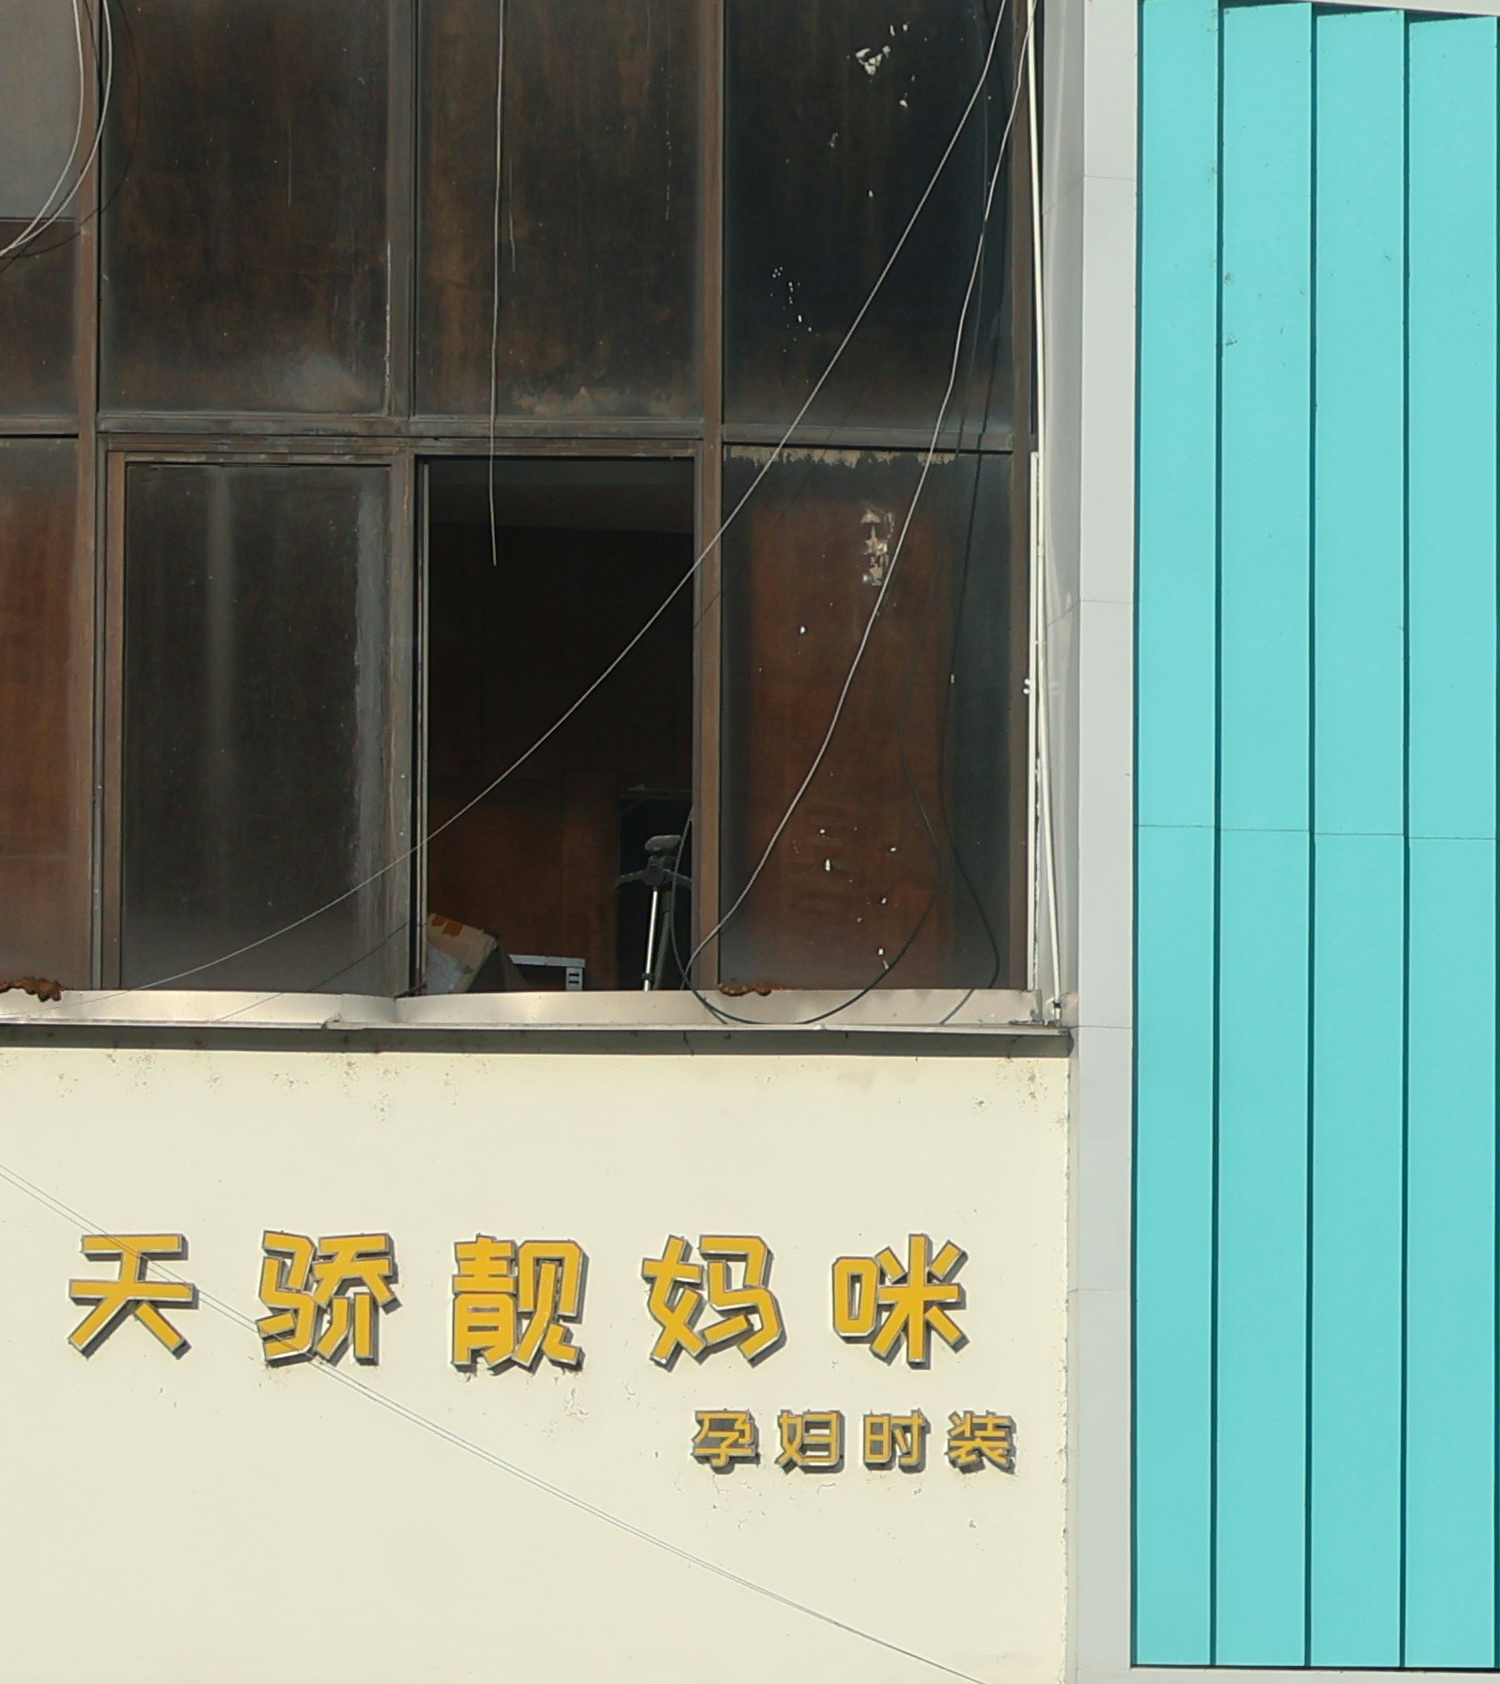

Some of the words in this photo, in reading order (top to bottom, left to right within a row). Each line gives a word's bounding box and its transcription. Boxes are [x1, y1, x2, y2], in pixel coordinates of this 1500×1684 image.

[68, 1231, 970, 1370] 天骄靓妈咪
[693, 1405, 1016, 1472] 孕妇时装
